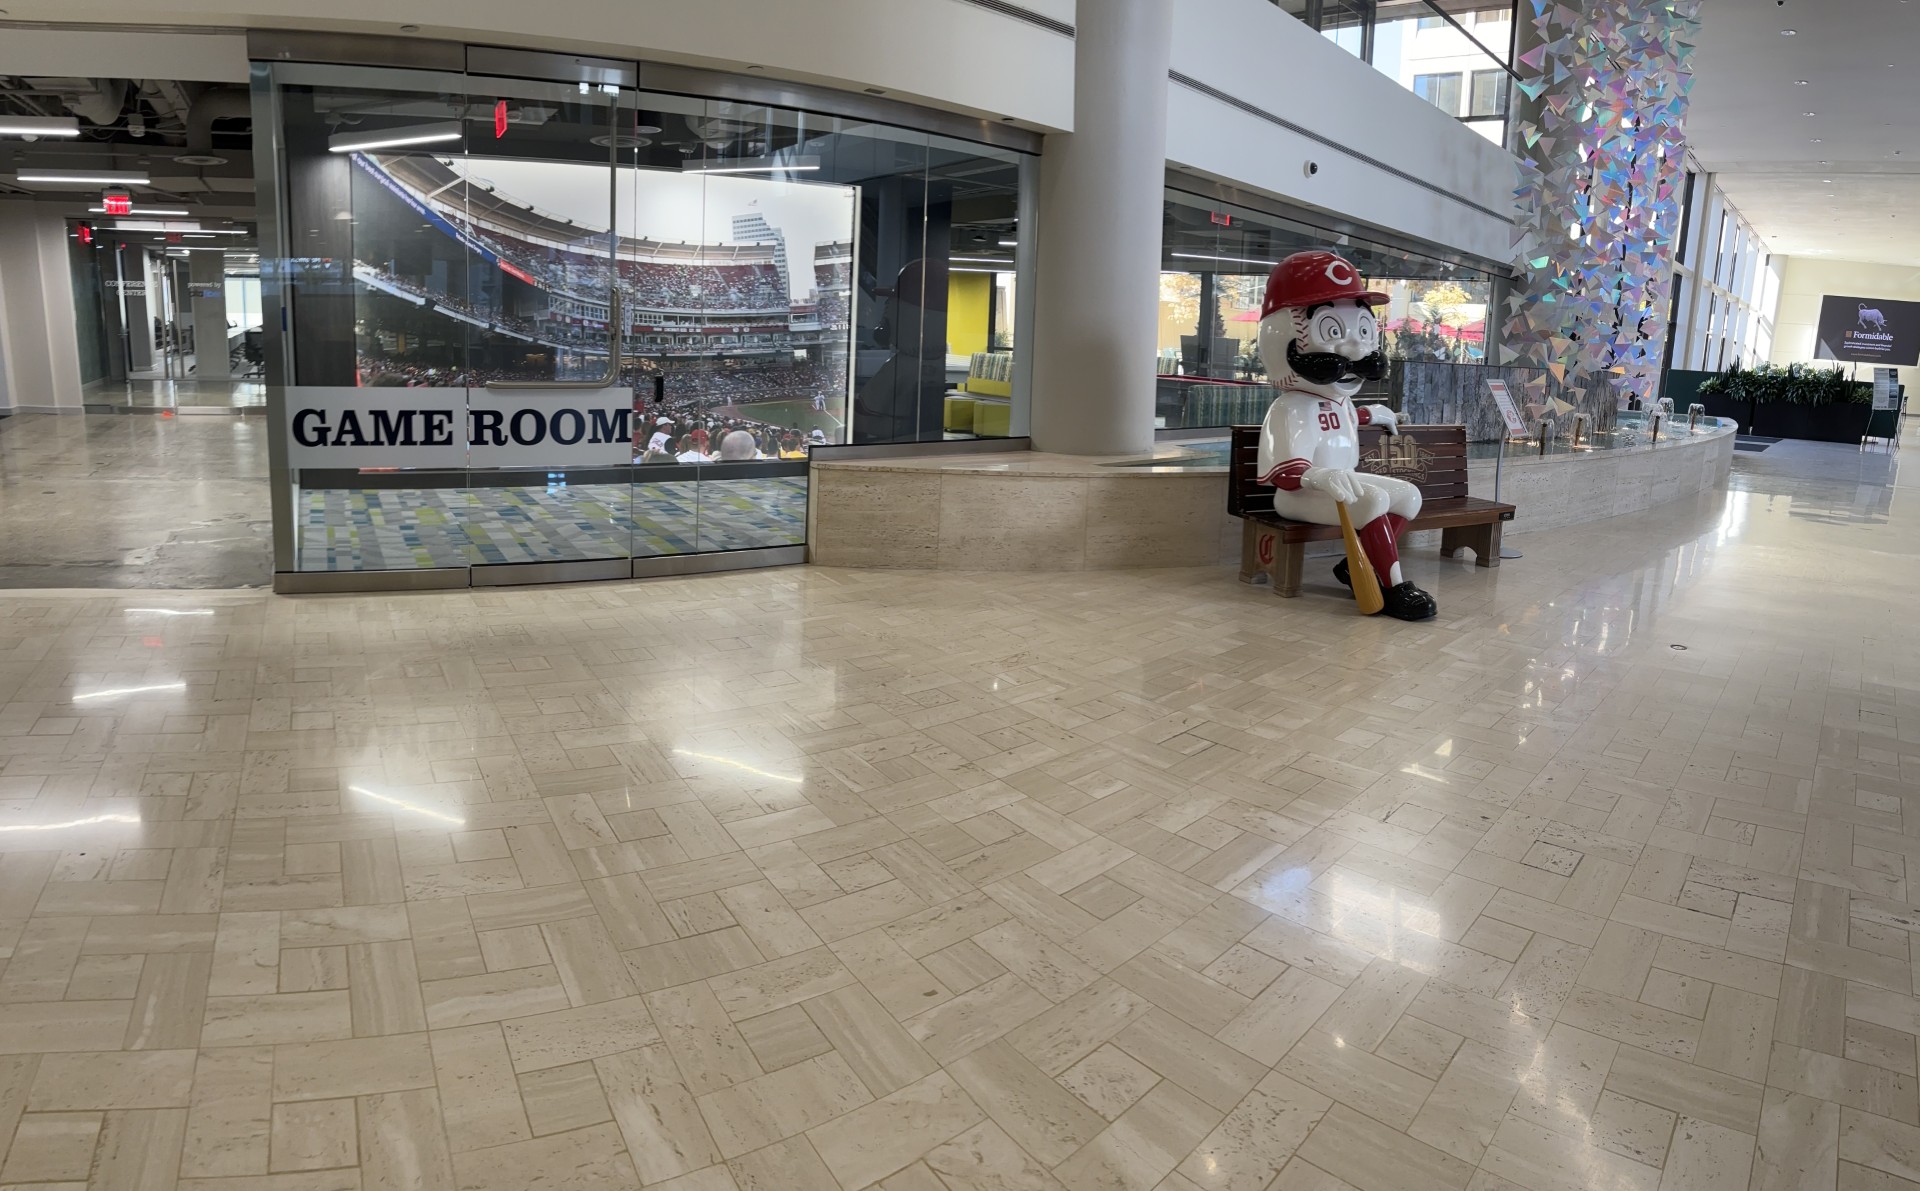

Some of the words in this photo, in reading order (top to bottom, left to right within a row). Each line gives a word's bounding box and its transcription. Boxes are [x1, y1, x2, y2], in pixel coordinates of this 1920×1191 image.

[1325, 261, 1352, 285] C
[1853, 330, 1894, 341] Formidable
[292, 408, 453, 447] GAME
[469, 408, 632, 447] ROOM
[1318, 412, 1340, 431] 90
[1378, 434, 1416, 468] 150
